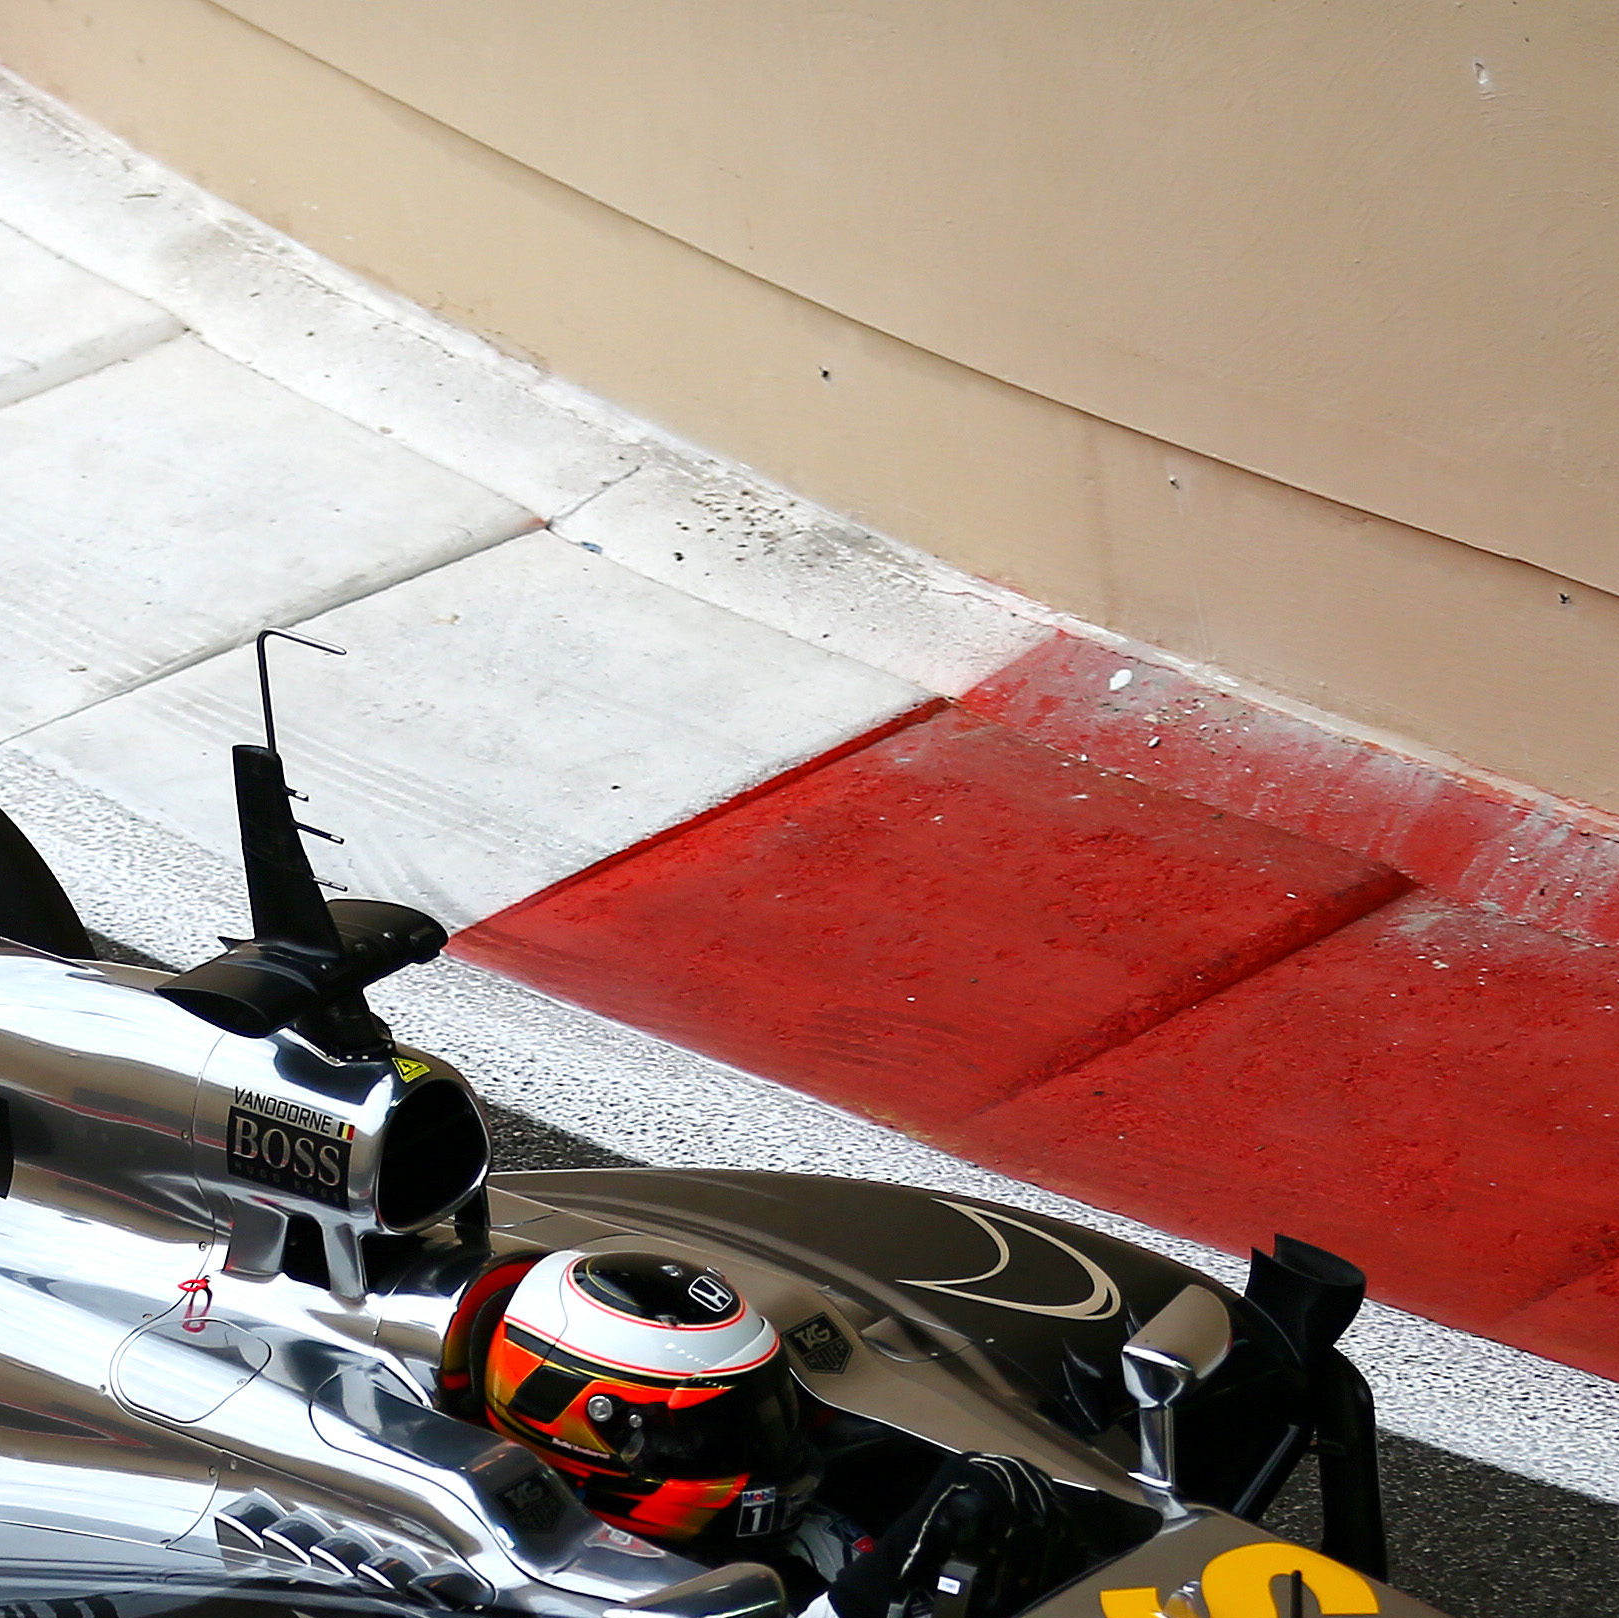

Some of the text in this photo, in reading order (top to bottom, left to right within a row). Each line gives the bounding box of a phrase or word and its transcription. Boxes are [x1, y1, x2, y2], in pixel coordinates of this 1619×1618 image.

[233, 1086, 334, 1135] VANDOORNE
[232, 1115, 342, 1188] BOSS
[795, 1323, 832, 1351] TAG
[503, 1481, 544, 1507] TAG
[751, 1506, 763, 1533] 1
